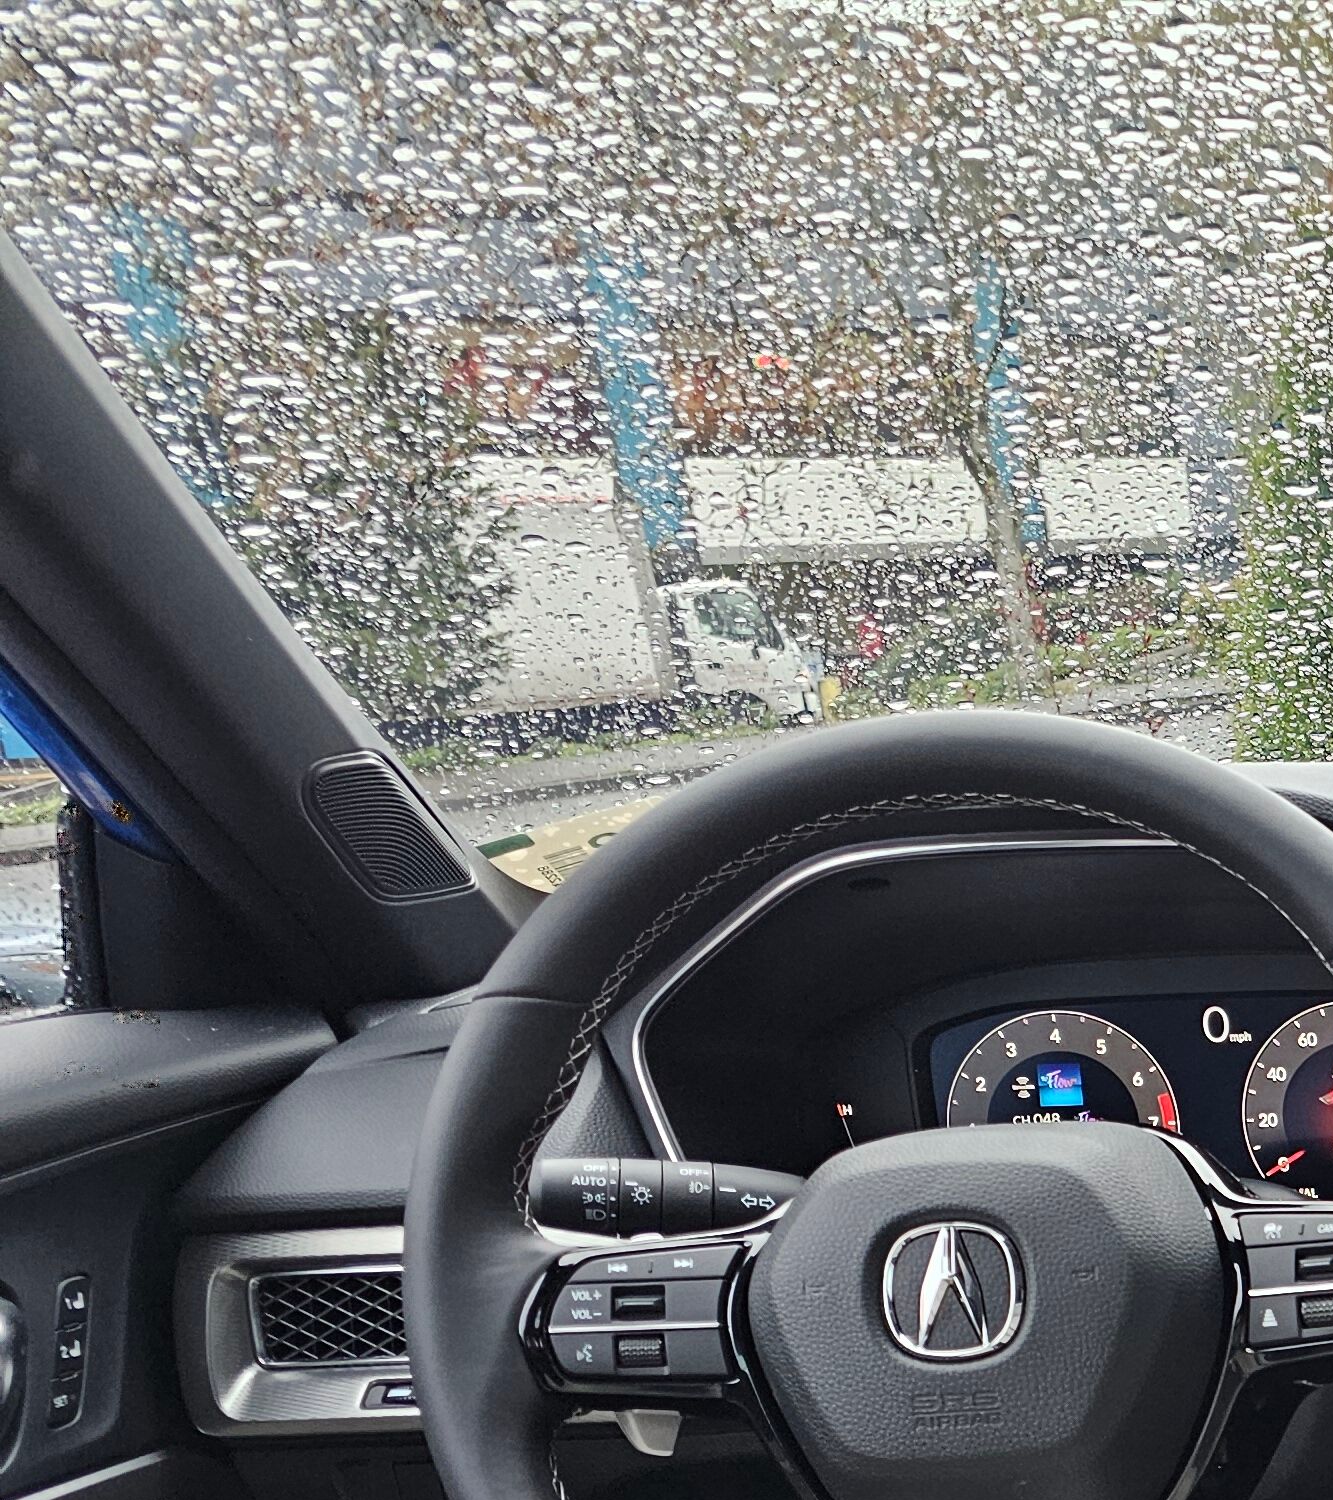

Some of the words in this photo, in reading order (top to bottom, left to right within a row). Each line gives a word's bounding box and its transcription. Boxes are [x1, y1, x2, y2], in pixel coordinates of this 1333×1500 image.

[1202, 1006, 1230, 1043] 0
[1229, 1030, 1252, 1044] mph
[1049, 1028, 1061, 1044] 4
[1297, 1032, 1317, 1048] 60
[1006, 1042, 1017, 1058] 3
[1096, 1039, 1107, 1055] 5
[1132, 1072, 1144, 1087] 6
[1266, 1066, 1287, 1082] 40
[975, 1077, 987, 1092] 2
[1258, 1113, 1279, 1128] 20
[583, 1164, 607, 1173] OFF
[679, 1168, 703, 1177] OFF
[571, 1175, 607, 1187] AUTO
